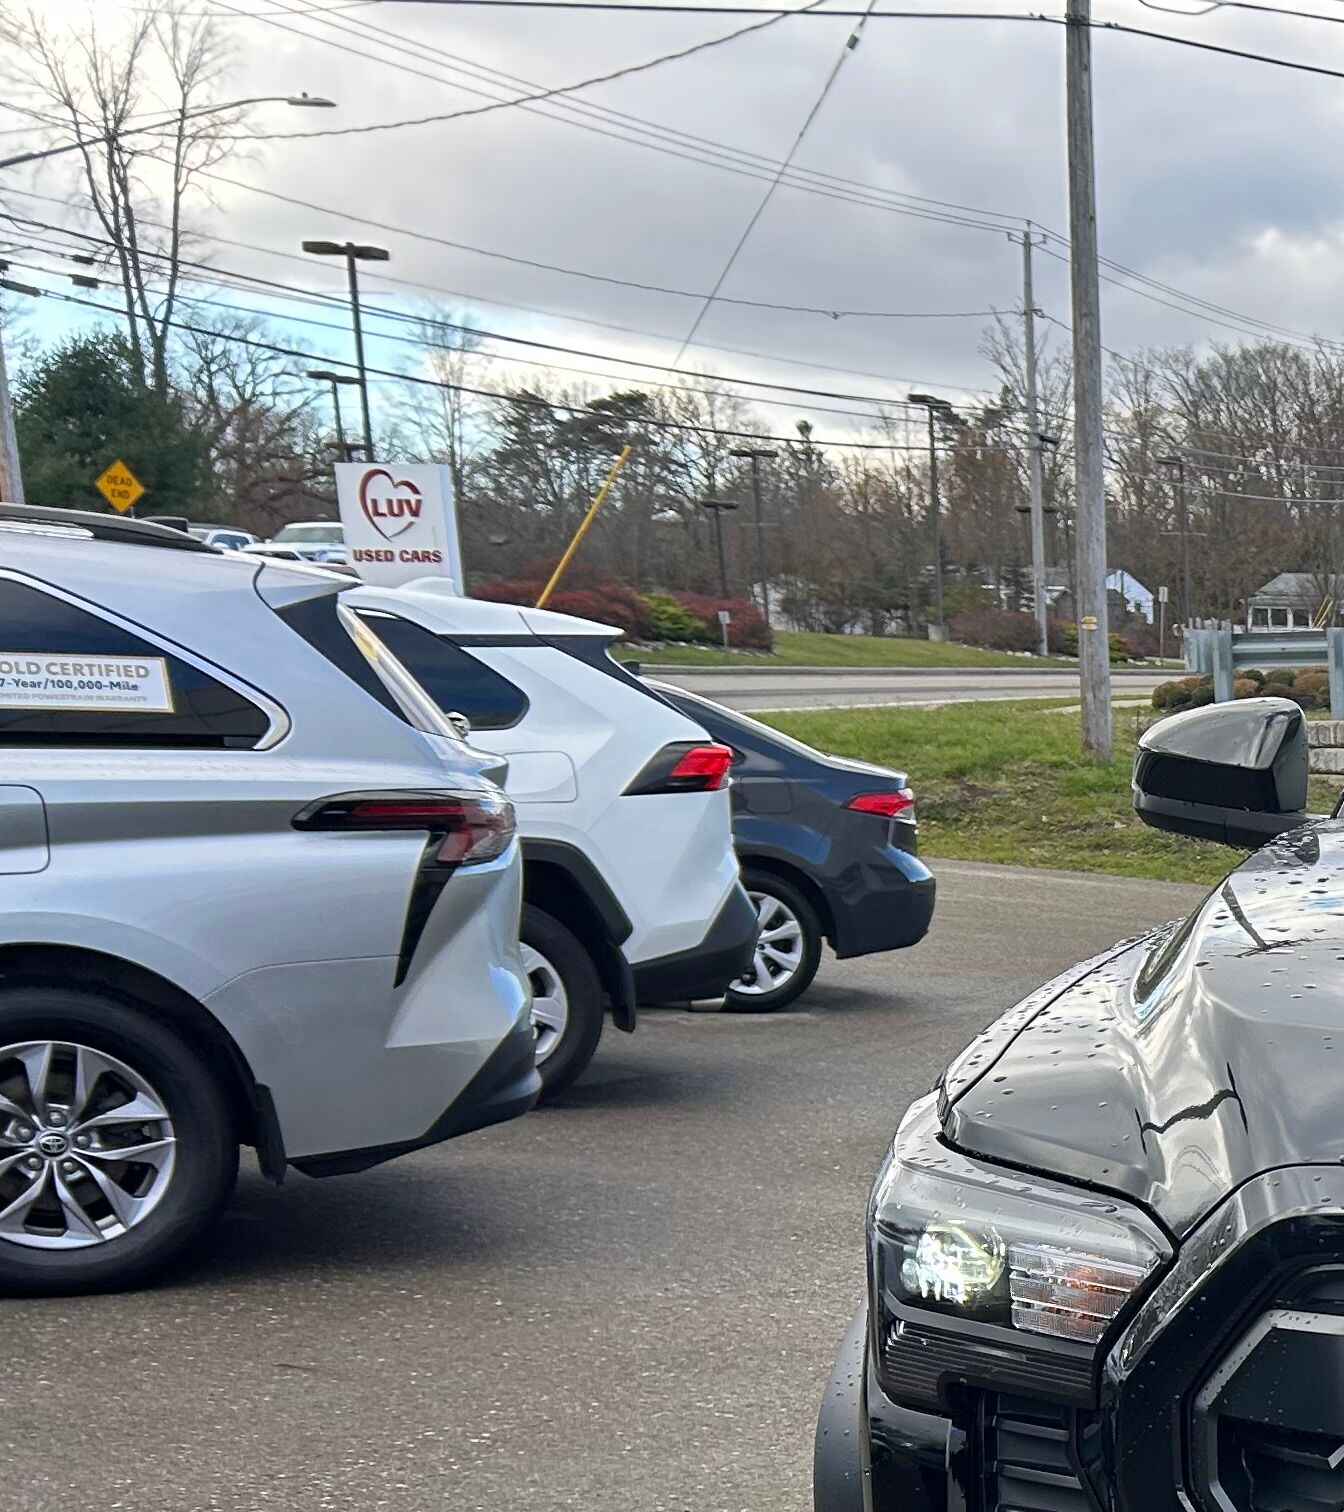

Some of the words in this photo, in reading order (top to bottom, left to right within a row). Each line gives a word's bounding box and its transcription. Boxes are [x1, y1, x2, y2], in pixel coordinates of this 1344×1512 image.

[106, 474, 133, 487] DEAD
[111, 488, 130, 499] END
[370, 497, 423, 518] LUV
[352, 548, 395, 563] USED
[398, 549, 443, 563] CARS
[45, 661, 150, 679] CERTIFIED
